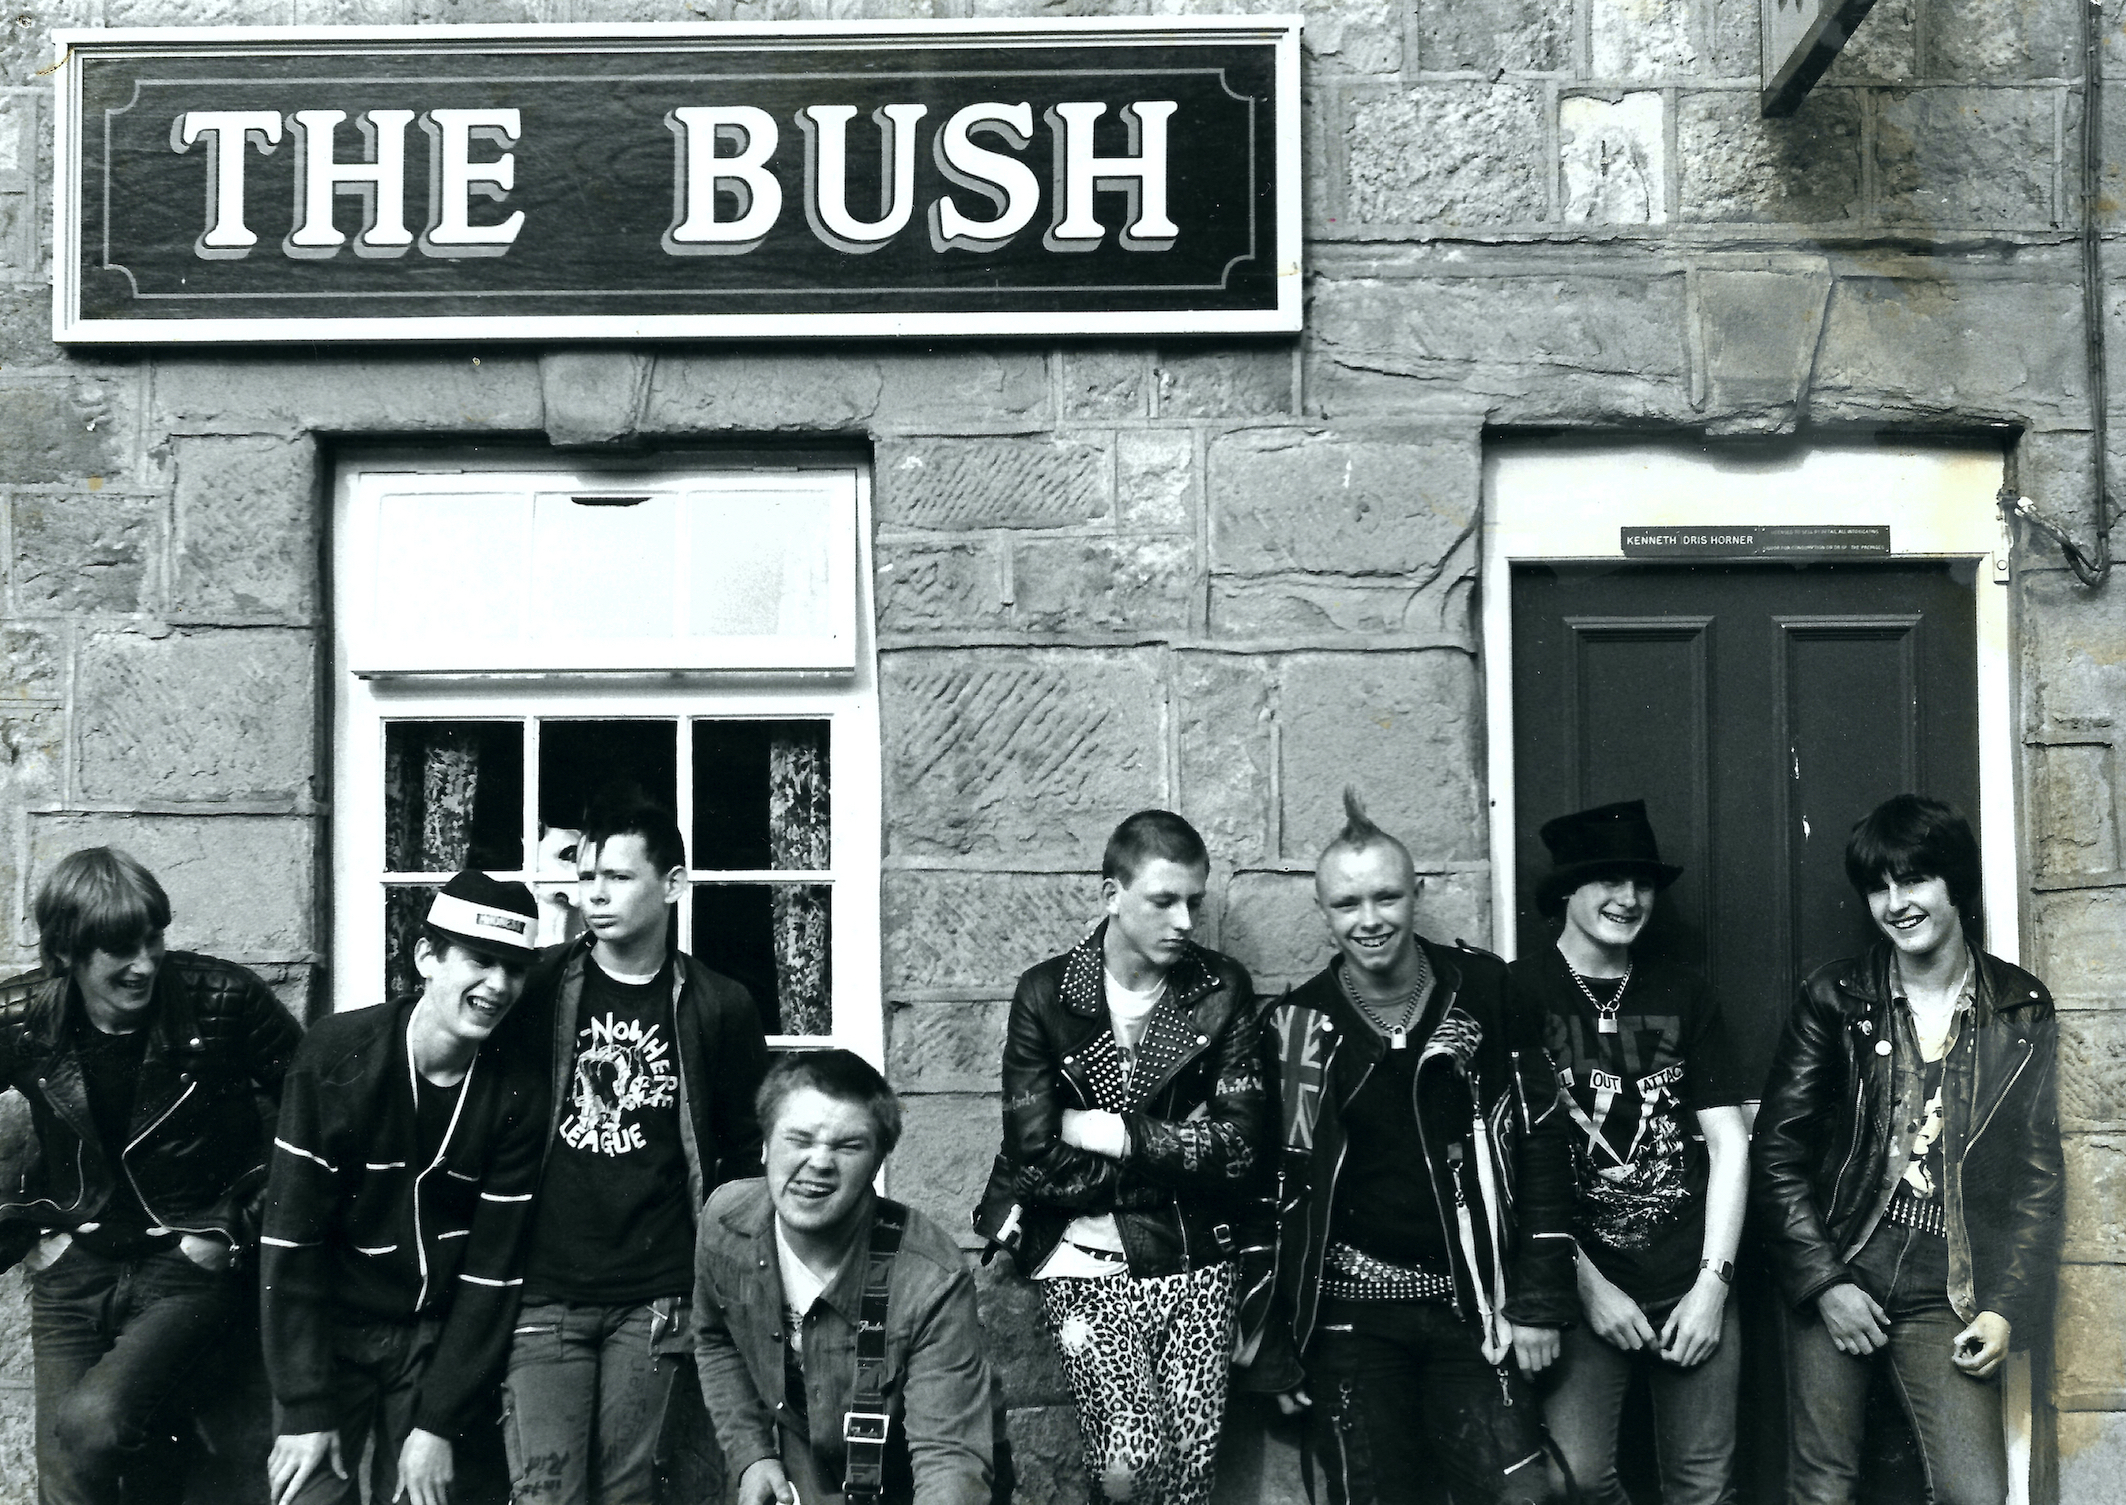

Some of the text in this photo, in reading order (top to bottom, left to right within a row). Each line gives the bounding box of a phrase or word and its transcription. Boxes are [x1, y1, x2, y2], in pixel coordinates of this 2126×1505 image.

[171, 100, 1179, 260] THE BUSH
[1626, 535, 1677, 546] KENNETH
[1710, 534, 1754, 545] HORNER
[1544, 1013, 1681, 1075] BLITZ
[1592, 1071, 1620, 1090] OUT
[1641, 1065, 1684, 1094] ATTAC
[558, 1113, 648, 1158] LEAGUE
